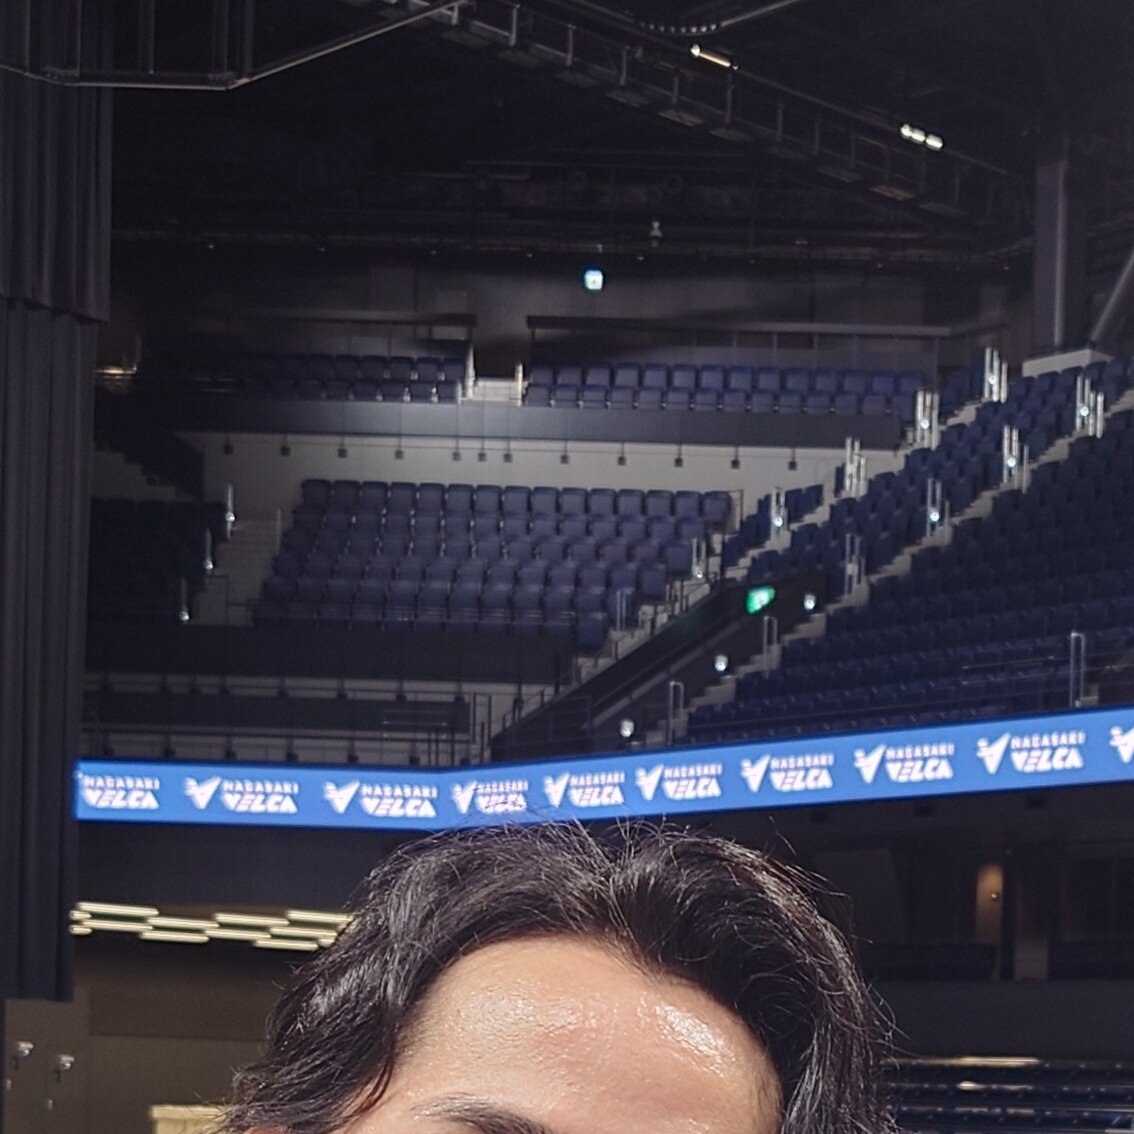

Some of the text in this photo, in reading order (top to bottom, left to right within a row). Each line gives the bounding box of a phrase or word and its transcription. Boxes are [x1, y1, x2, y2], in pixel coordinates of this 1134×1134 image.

[1010, 731, 1086, 749] NAGASAKI
[770, 753, 834, 769] NAGASAKI
[886, 743, 955, 760] NAGASAKI
[1010, 747, 1084, 773] VELCA
[570, 772, 625, 786] NAGASAKI
[664, 763, 722, 778] NAGASAKI
[769, 768, 833, 792] VELCA
[885, 758, 953, 783] VELCA
[84, 775, 160, 790] NAGASAKI
[222, 779, 298, 795] NAGASAKI
[361, 784, 438, 798] NAGASAKI
[663, 777, 722, 800] VELCA
[82, 789, 159, 810] VELCA
[222, 793, 298, 814] VELCA
[569, 785, 625, 808] VELCA
[361, 798, 436, 818] VELCA
